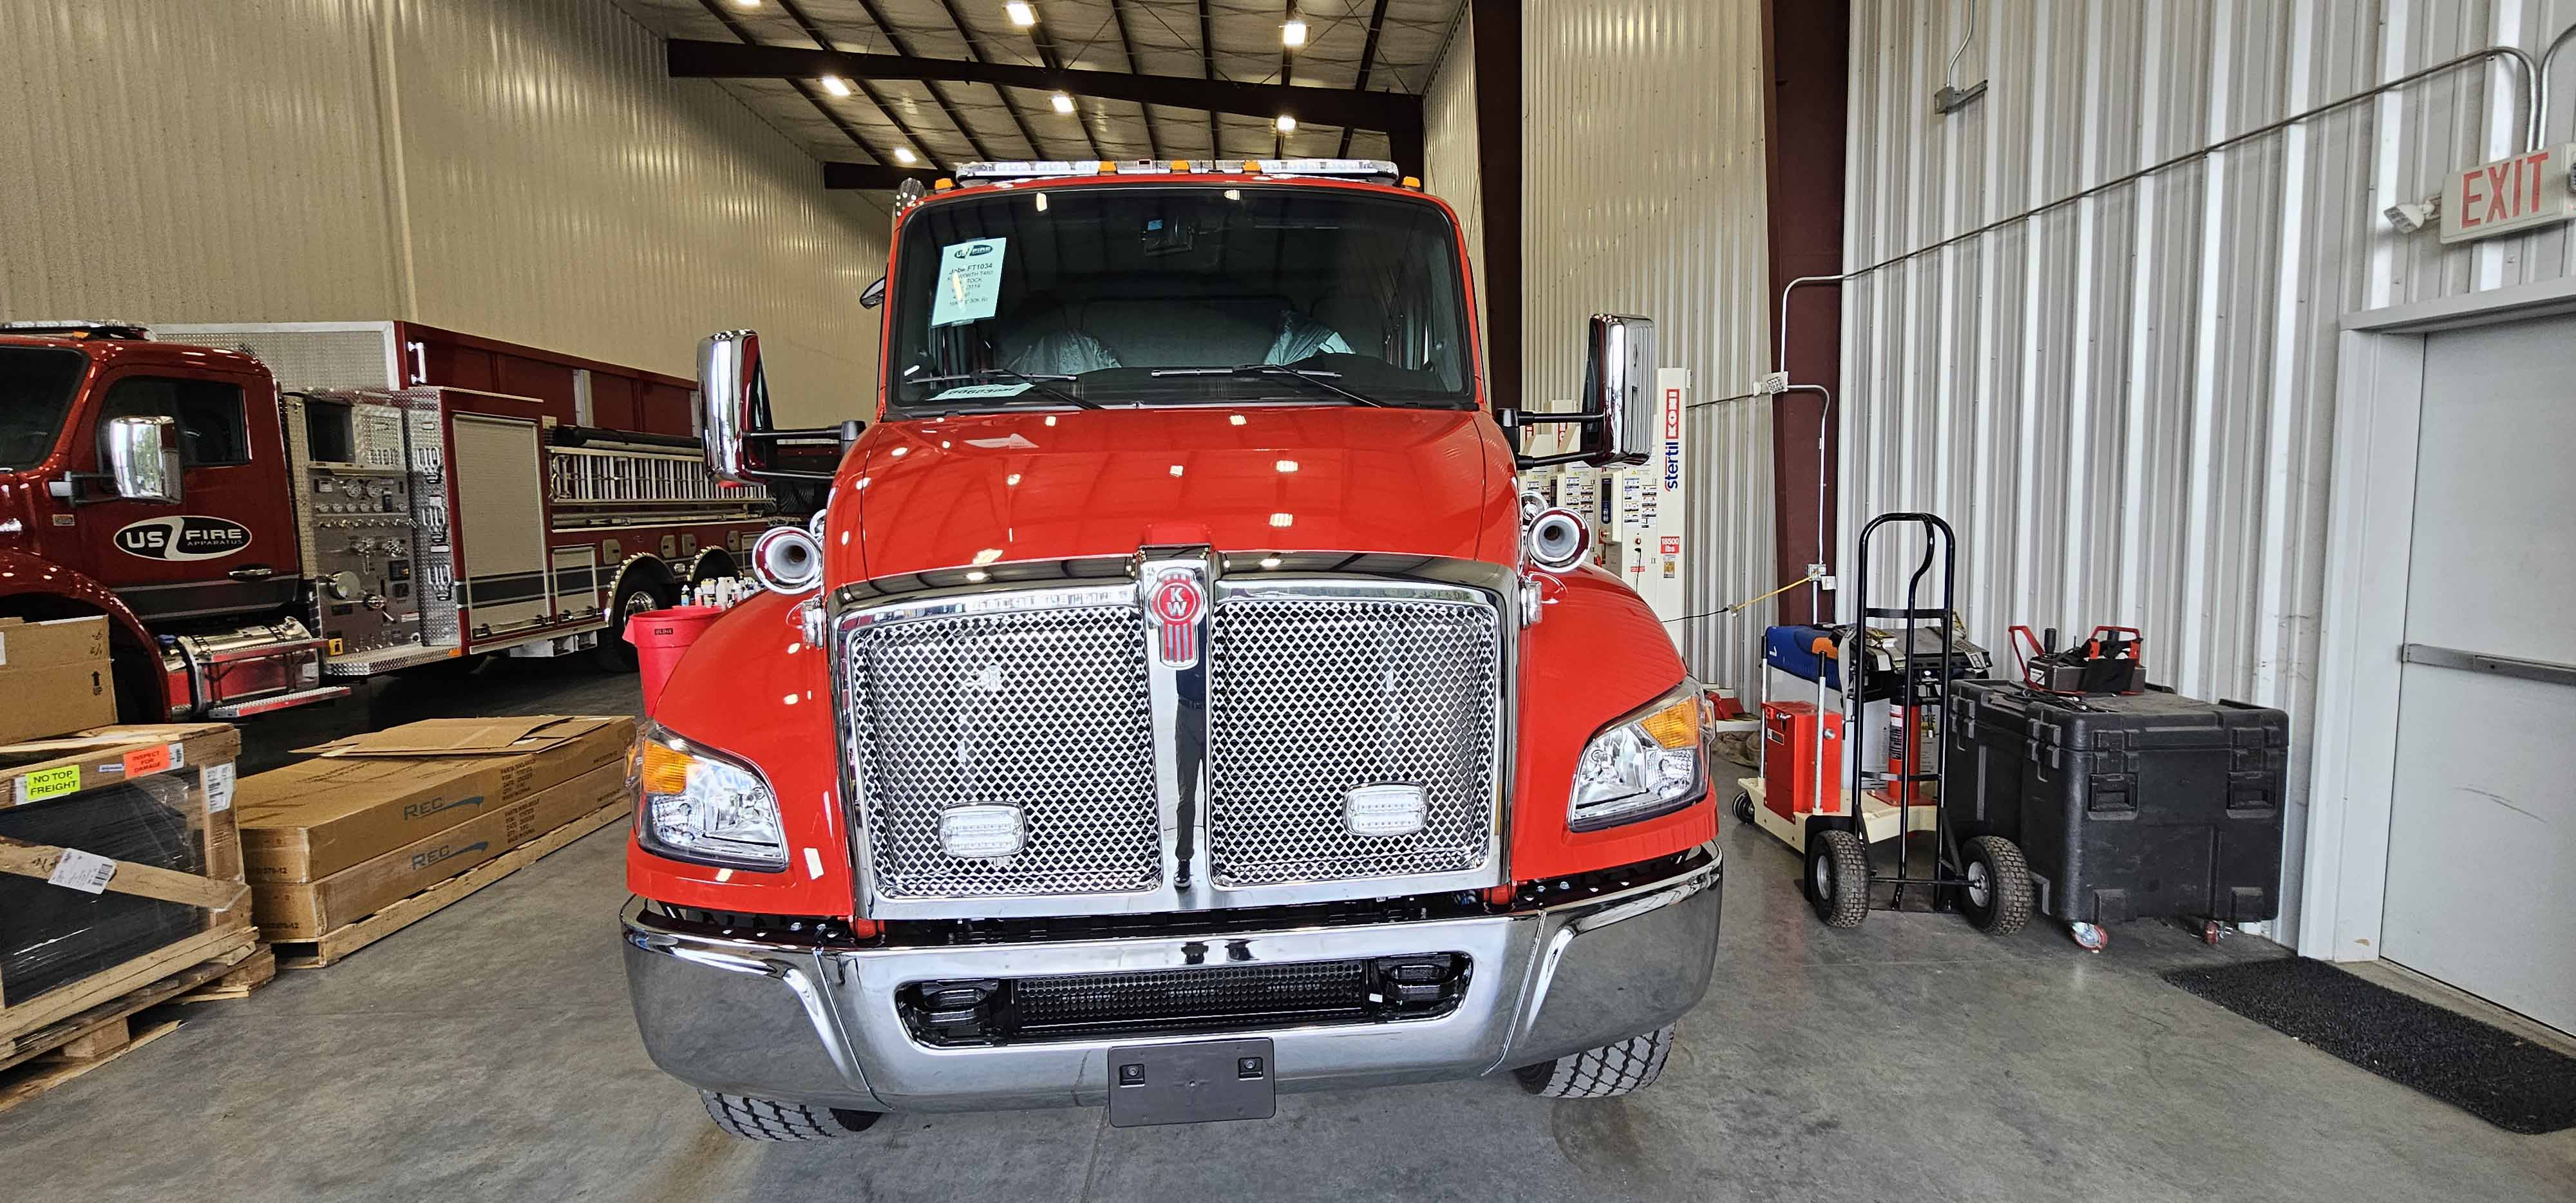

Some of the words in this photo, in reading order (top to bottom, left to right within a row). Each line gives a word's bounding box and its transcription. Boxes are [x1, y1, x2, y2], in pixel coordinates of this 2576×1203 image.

[2461, 152, 2548, 230] EXIT
[967, 263, 992, 272] FT1034
[1667, 389, 1680, 439] KONI
[1665, 442, 1679, 489] stertil
[126, 531, 164, 548] US
[185, 529, 242, 540] FIRE
[1170, 587, 1184, 602] K
[1166, 602, 1188, 616] W
[133, 750, 160, 761] INSPECT
[134, 762, 161, 773] DAMAGE
[33, 775, 50, 784] NO
[52, 770, 73, 780] TOP
[30, 780, 77, 795] FREIGHT
